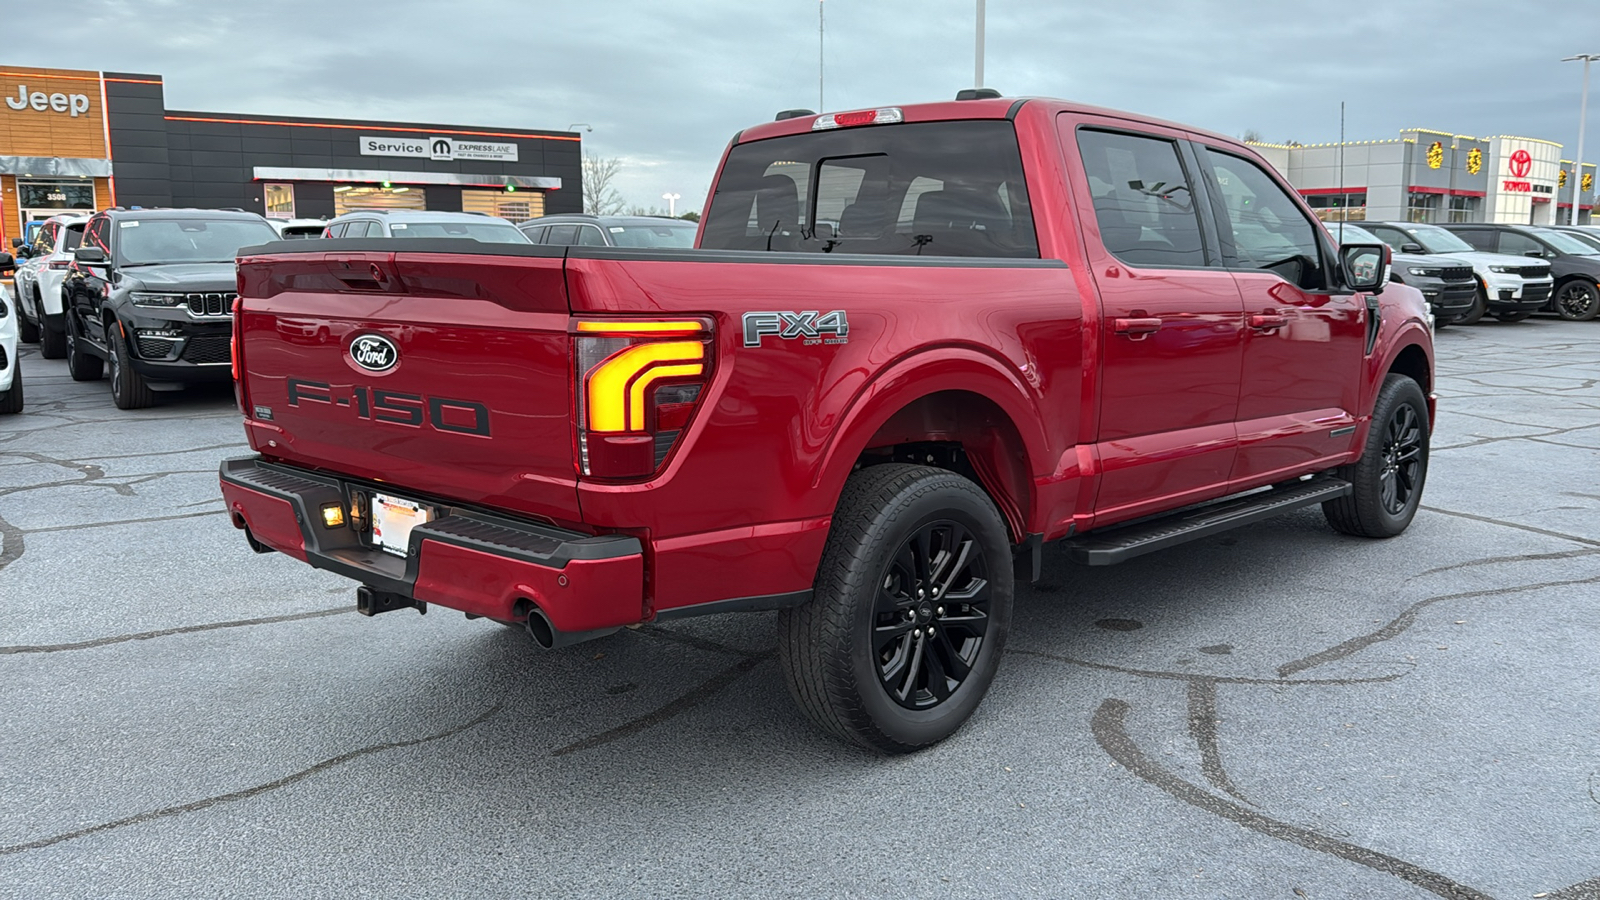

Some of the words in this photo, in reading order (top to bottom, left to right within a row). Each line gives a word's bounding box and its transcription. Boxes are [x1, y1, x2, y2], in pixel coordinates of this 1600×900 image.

[5, 84, 90, 118] Jeep
[368, 141, 423, 153] Service
[47, 193, 66, 201] 3508
[1503, 181, 1531, 192] TOYOTA
[741, 310, 849, 348] FX4
[357, 339, 388, 365] Ford
[287, 376, 493, 439] F-150
